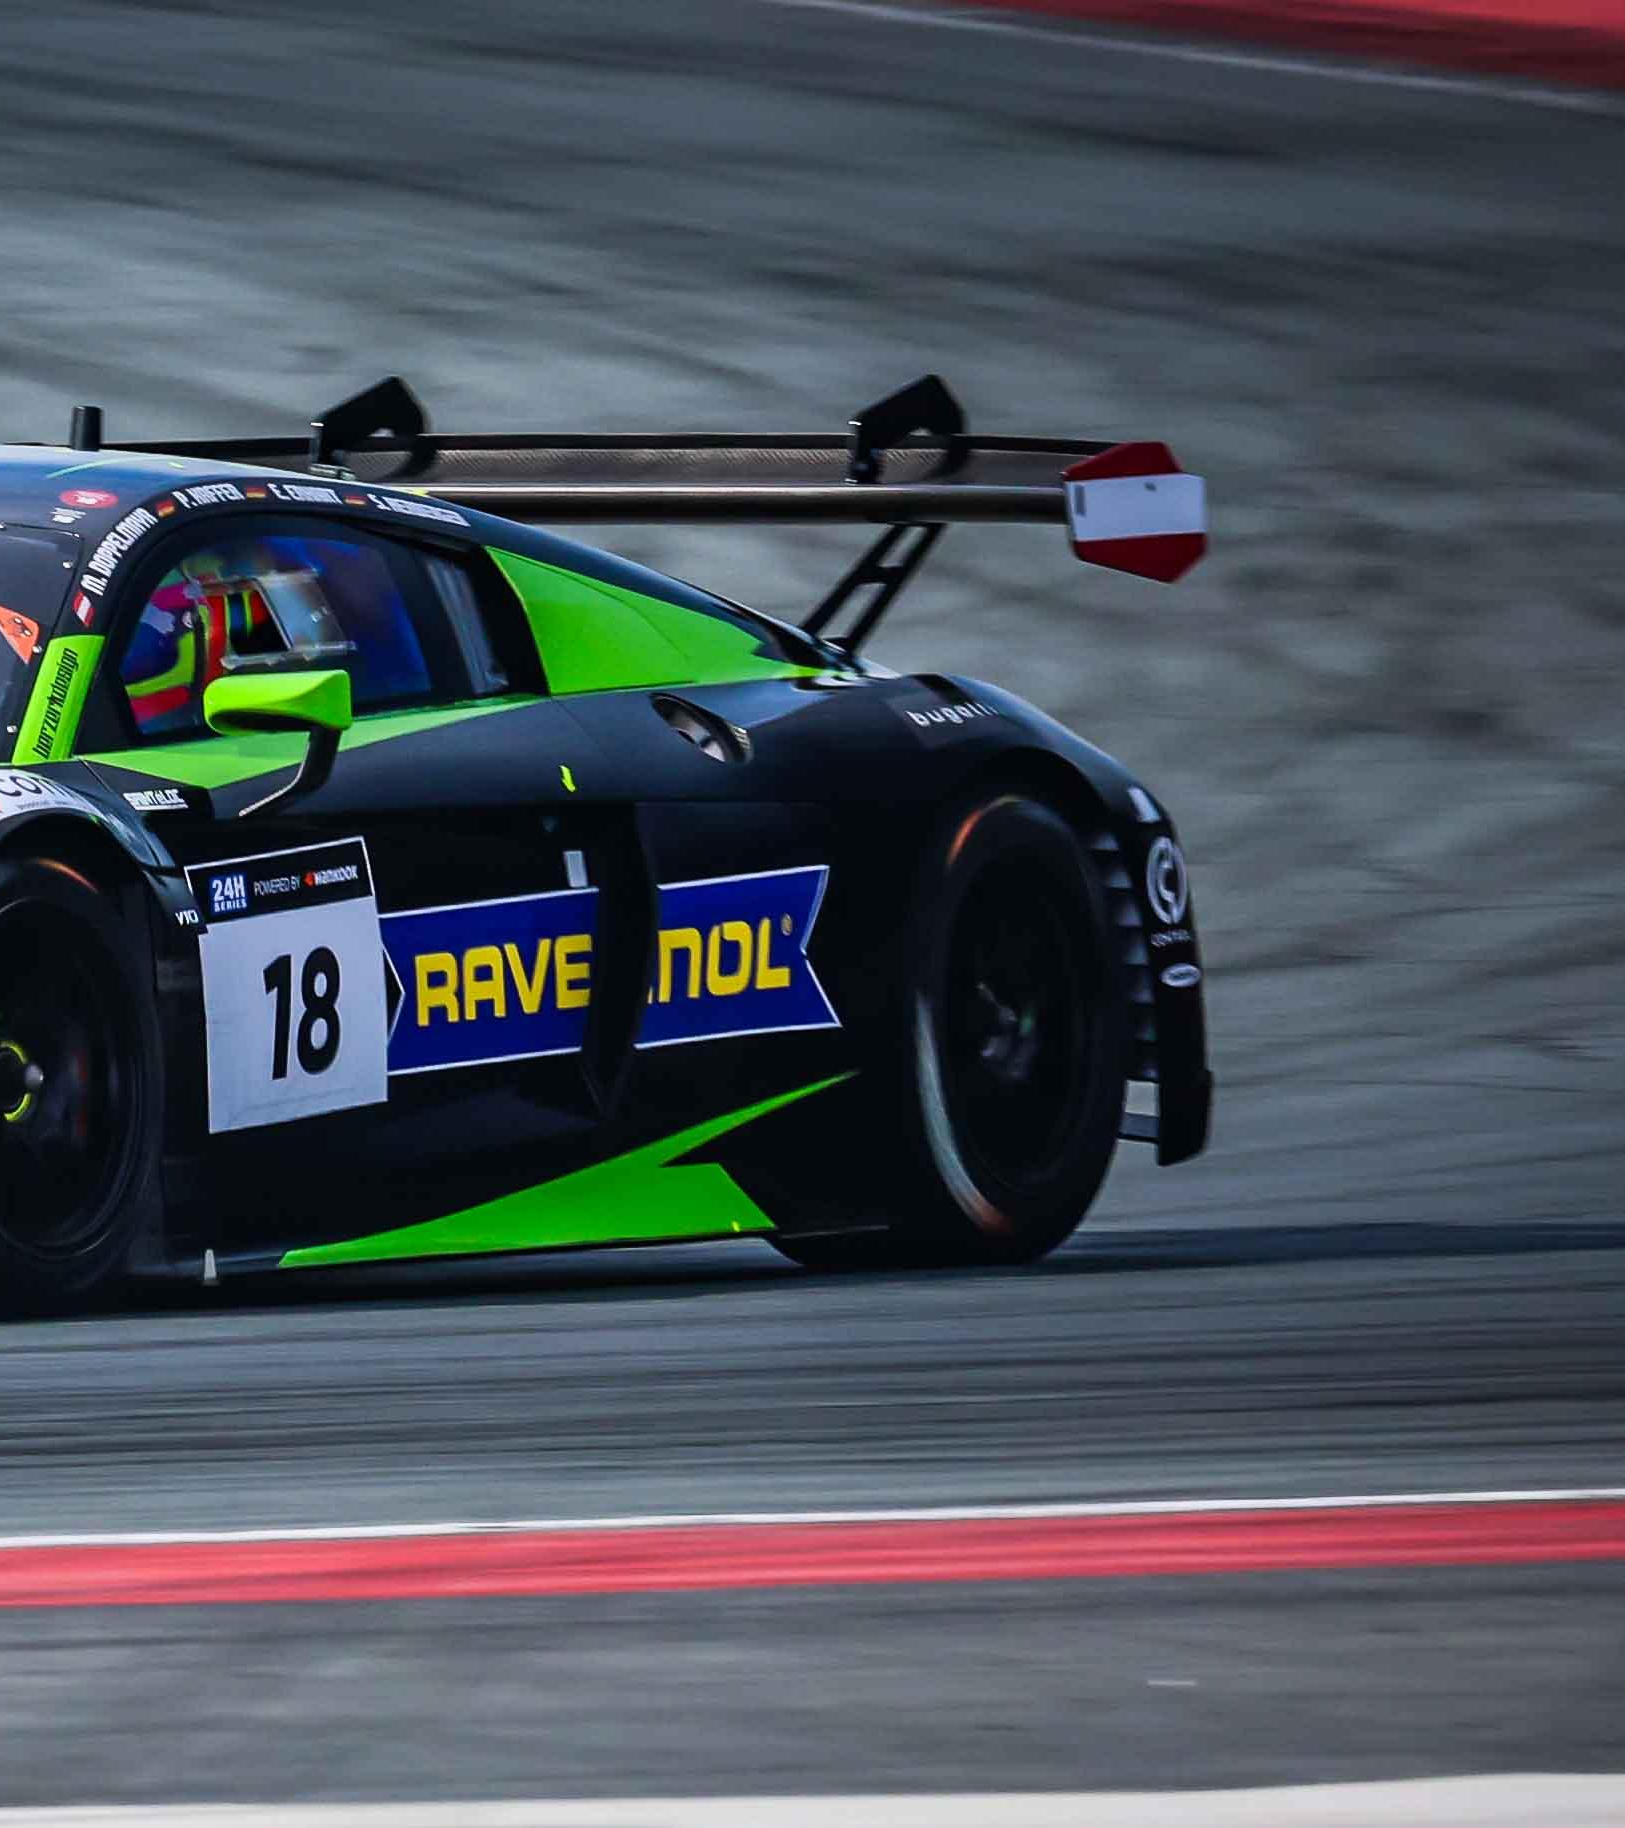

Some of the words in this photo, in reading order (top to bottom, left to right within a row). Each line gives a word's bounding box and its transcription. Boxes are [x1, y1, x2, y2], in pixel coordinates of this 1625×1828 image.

[212, 875, 246, 902] 24H
[254, 877, 290, 896] POWERED
[213, 899, 248, 913] SERIES
[262, 946, 341, 1081] 18
